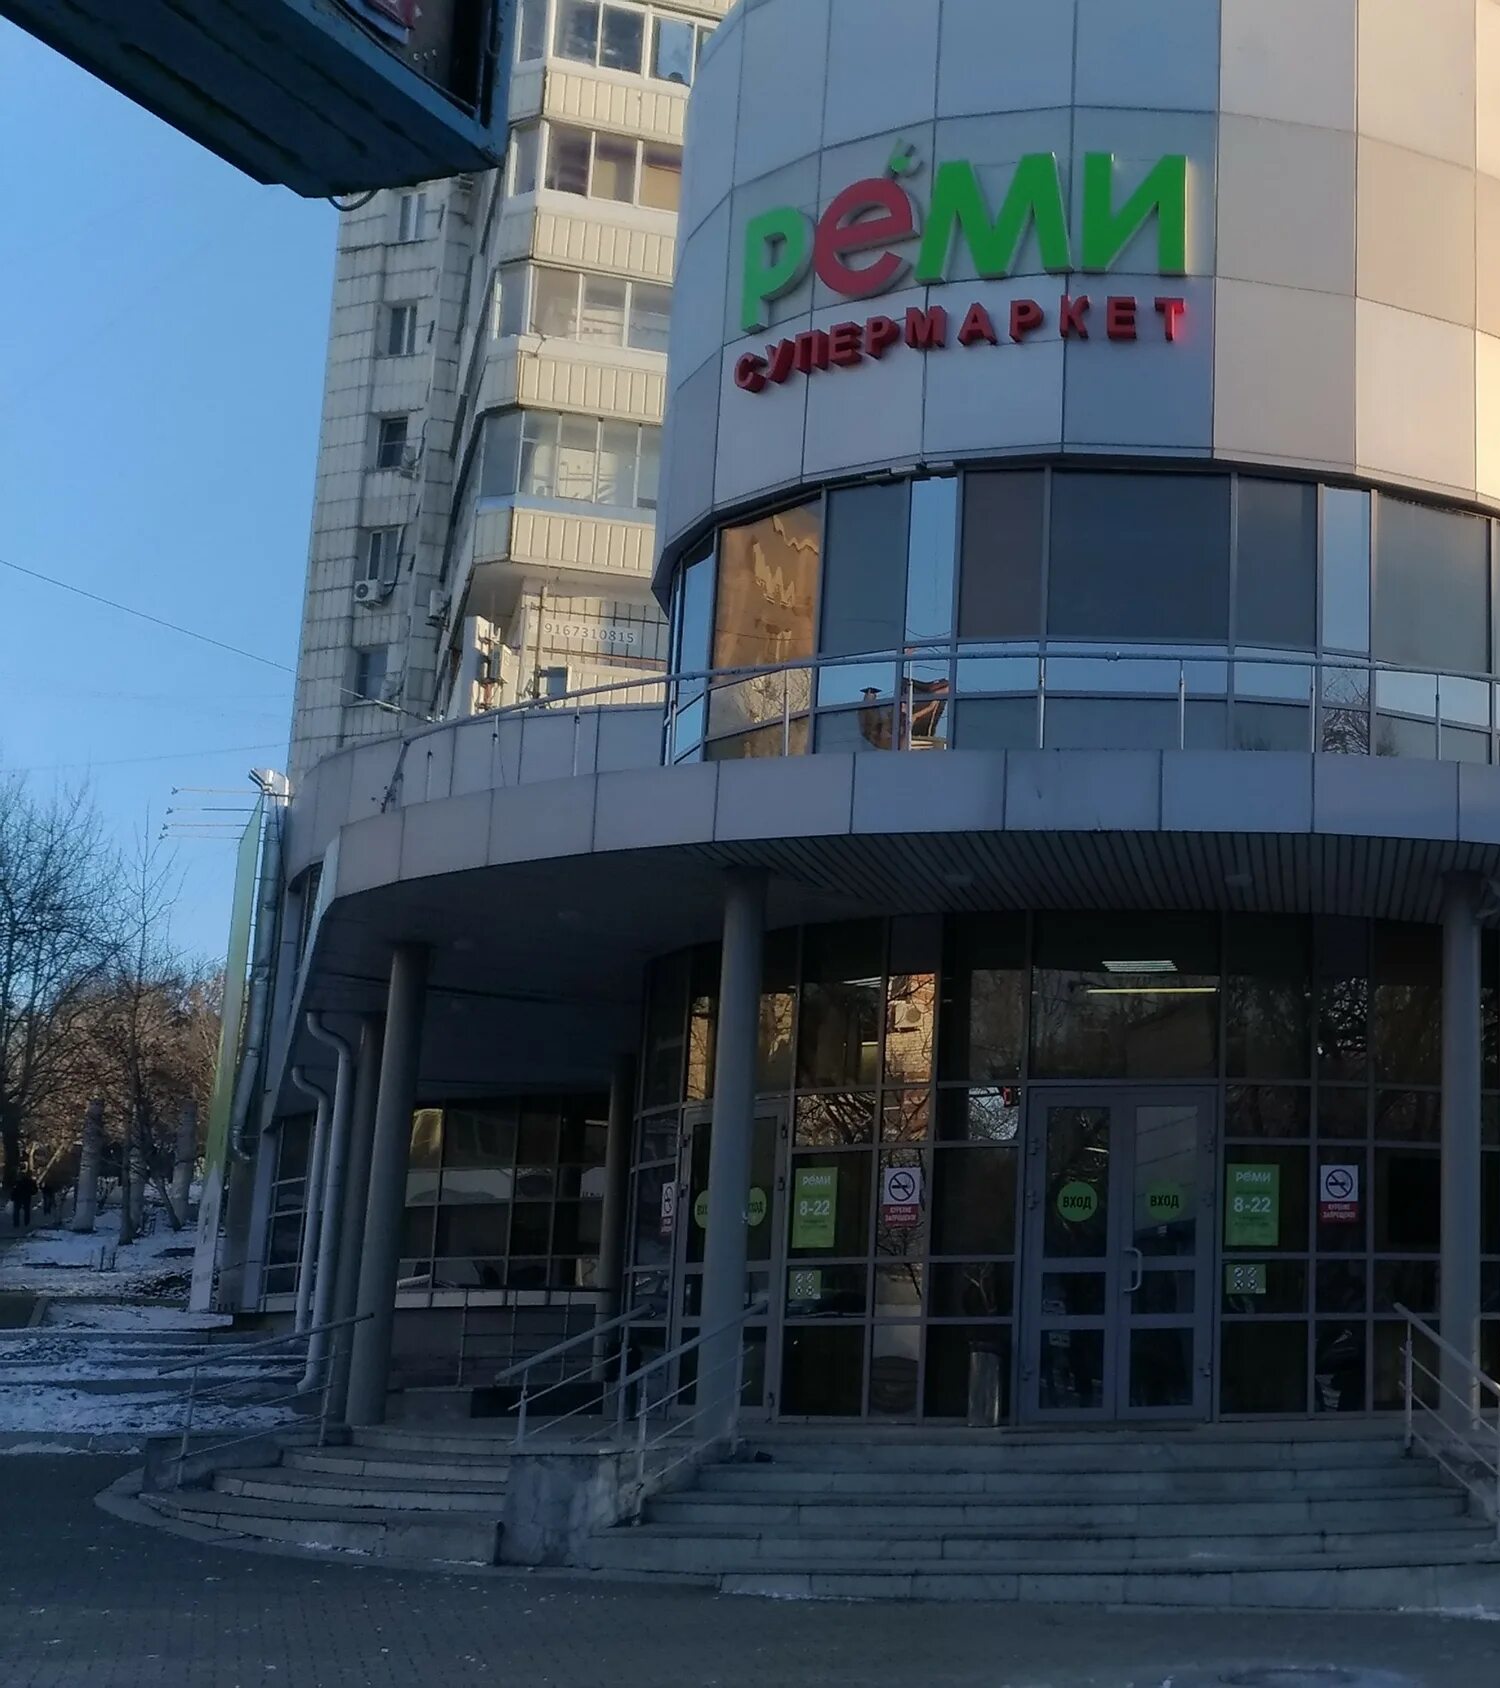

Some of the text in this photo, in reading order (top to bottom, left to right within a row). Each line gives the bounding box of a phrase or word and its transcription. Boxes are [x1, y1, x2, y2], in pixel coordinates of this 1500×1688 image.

[733, 295, 1186, 394] СУПЕРМАРКЕТ
[799, 1200, 830, 1216] 8-22
[1063, 1196, 1092, 1210] ВХОД
[1150, 1194, 1180, 1208] ВХОД
[1233, 1196, 1271, 1213] 8-22
